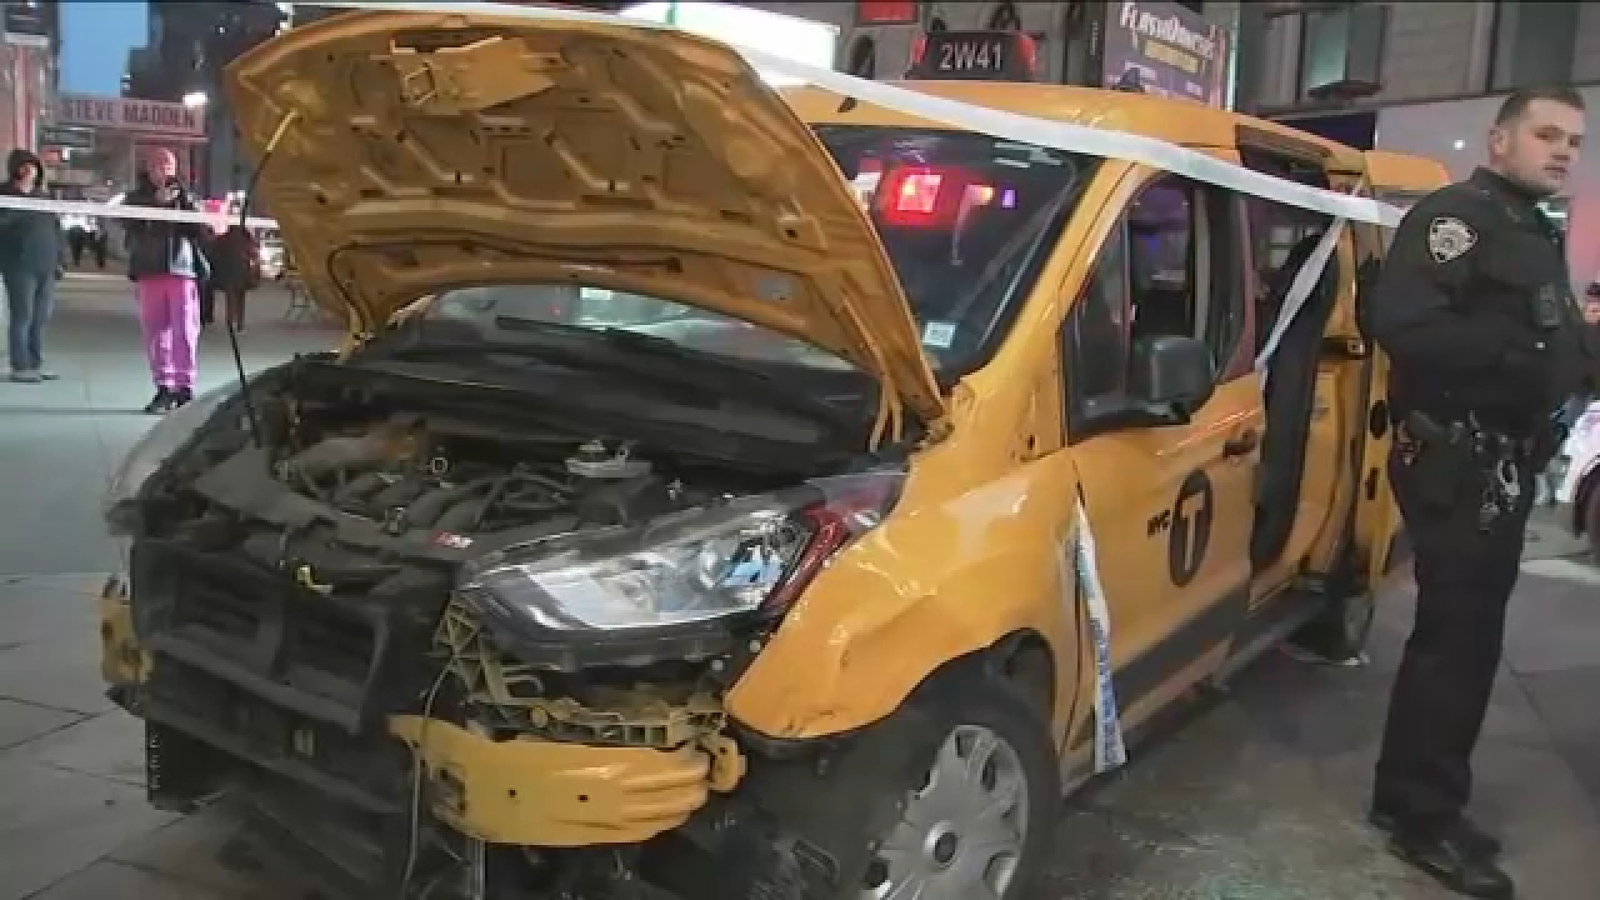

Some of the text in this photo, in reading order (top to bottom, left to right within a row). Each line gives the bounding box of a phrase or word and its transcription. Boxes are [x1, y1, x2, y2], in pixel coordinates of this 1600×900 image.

[940, 41, 1002, 70] 2W41
[61, 99, 197, 130] STEVE MADDEN
